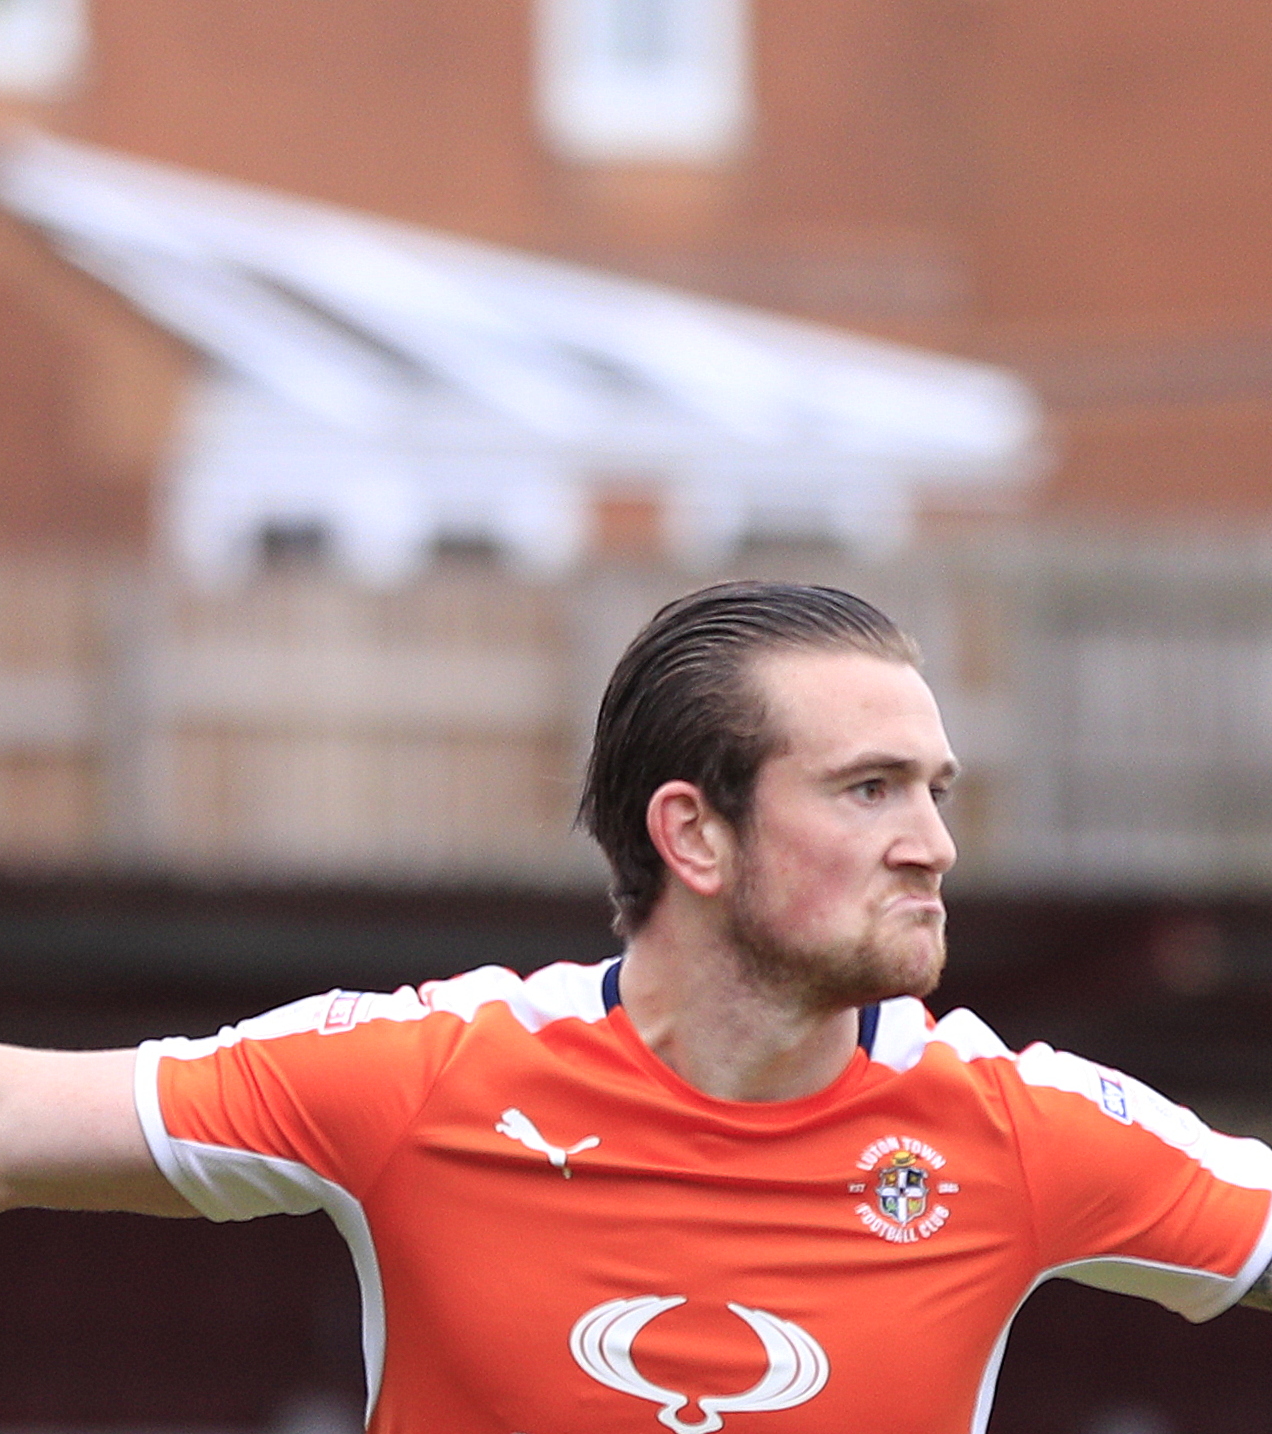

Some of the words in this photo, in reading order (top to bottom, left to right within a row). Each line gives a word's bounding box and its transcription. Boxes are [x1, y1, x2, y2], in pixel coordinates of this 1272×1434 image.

[855, 1136, 900, 1171] LUTON
[900, 1135, 947, 1170] TOWN
[854, 1202, 919, 1243] FOOTBALL
[918, 1203, 951, 1239] CLUB
